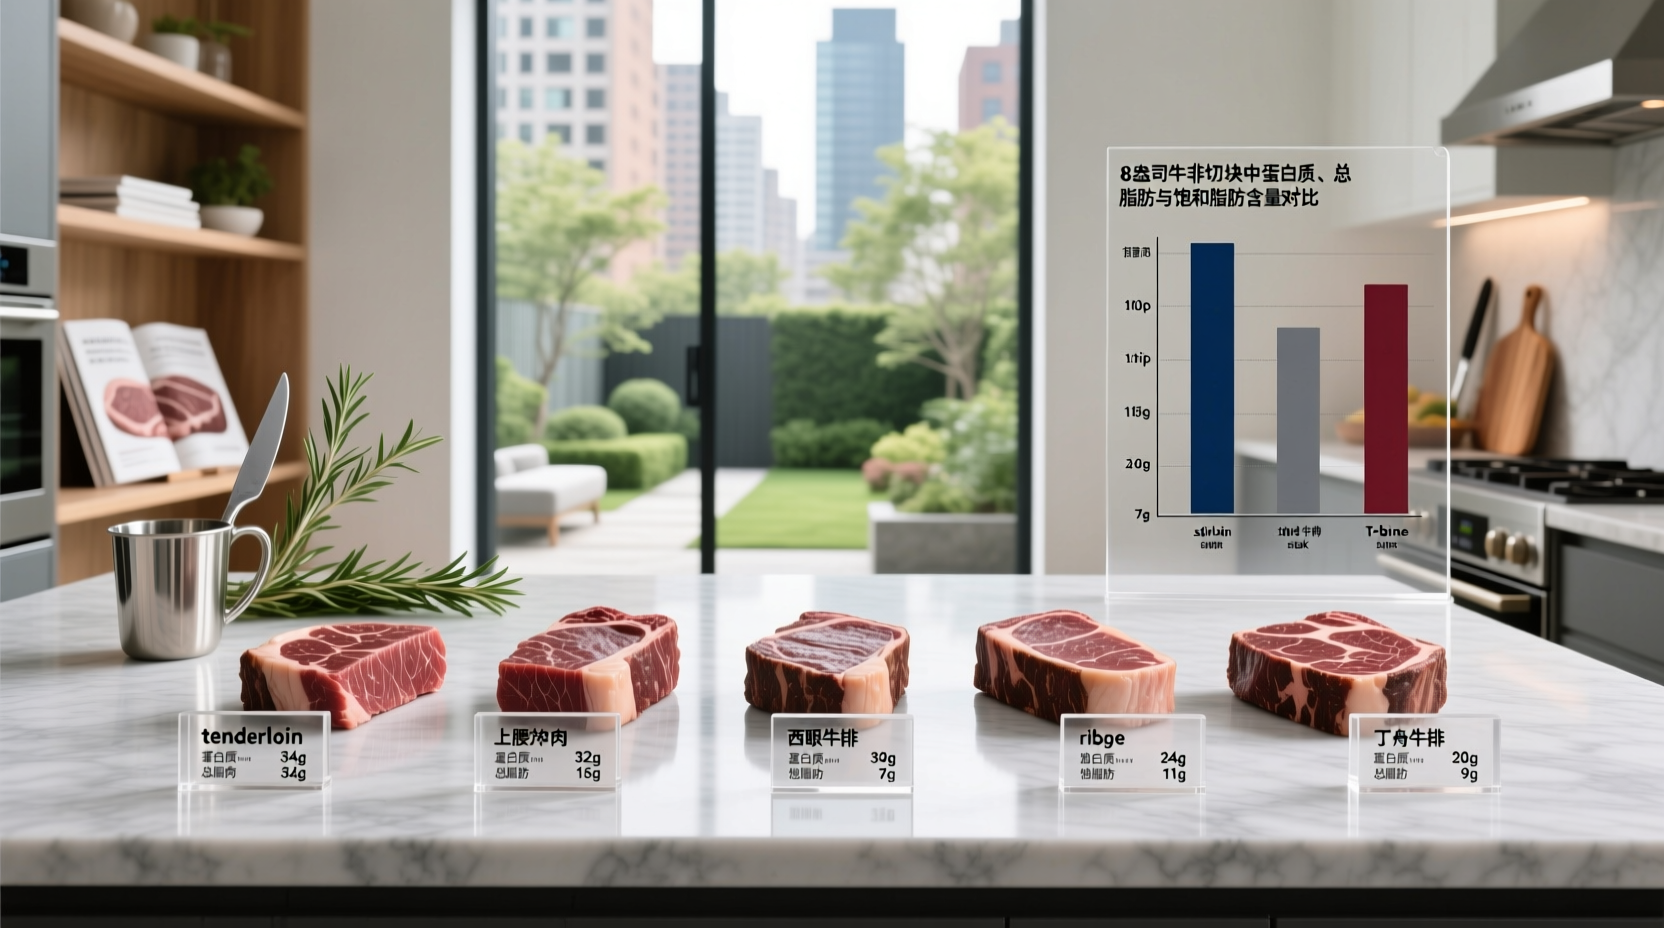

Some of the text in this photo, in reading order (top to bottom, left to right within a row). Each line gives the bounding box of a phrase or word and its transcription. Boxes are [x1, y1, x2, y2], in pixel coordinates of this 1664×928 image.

[1119, 187, 1319, 208] 脂肪与饱和脂肪含量对比
[1135, 508, 1150, 523] 7g
[201, 726, 303, 745] tenderloin
[1080, 728, 1125, 749] ribge
[280, 750, 306, 766] 34g
[575, 751, 601, 767] 32g
[871, 752, 896, 767] 30g
[1161, 751, 1186, 768] 24g
[1452, 751, 1478, 767] 20g
[879, 768, 895, 783] 7g
[1163, 768, 1186, 783] 11g
[1461, 767, 1478, 783] 9g
